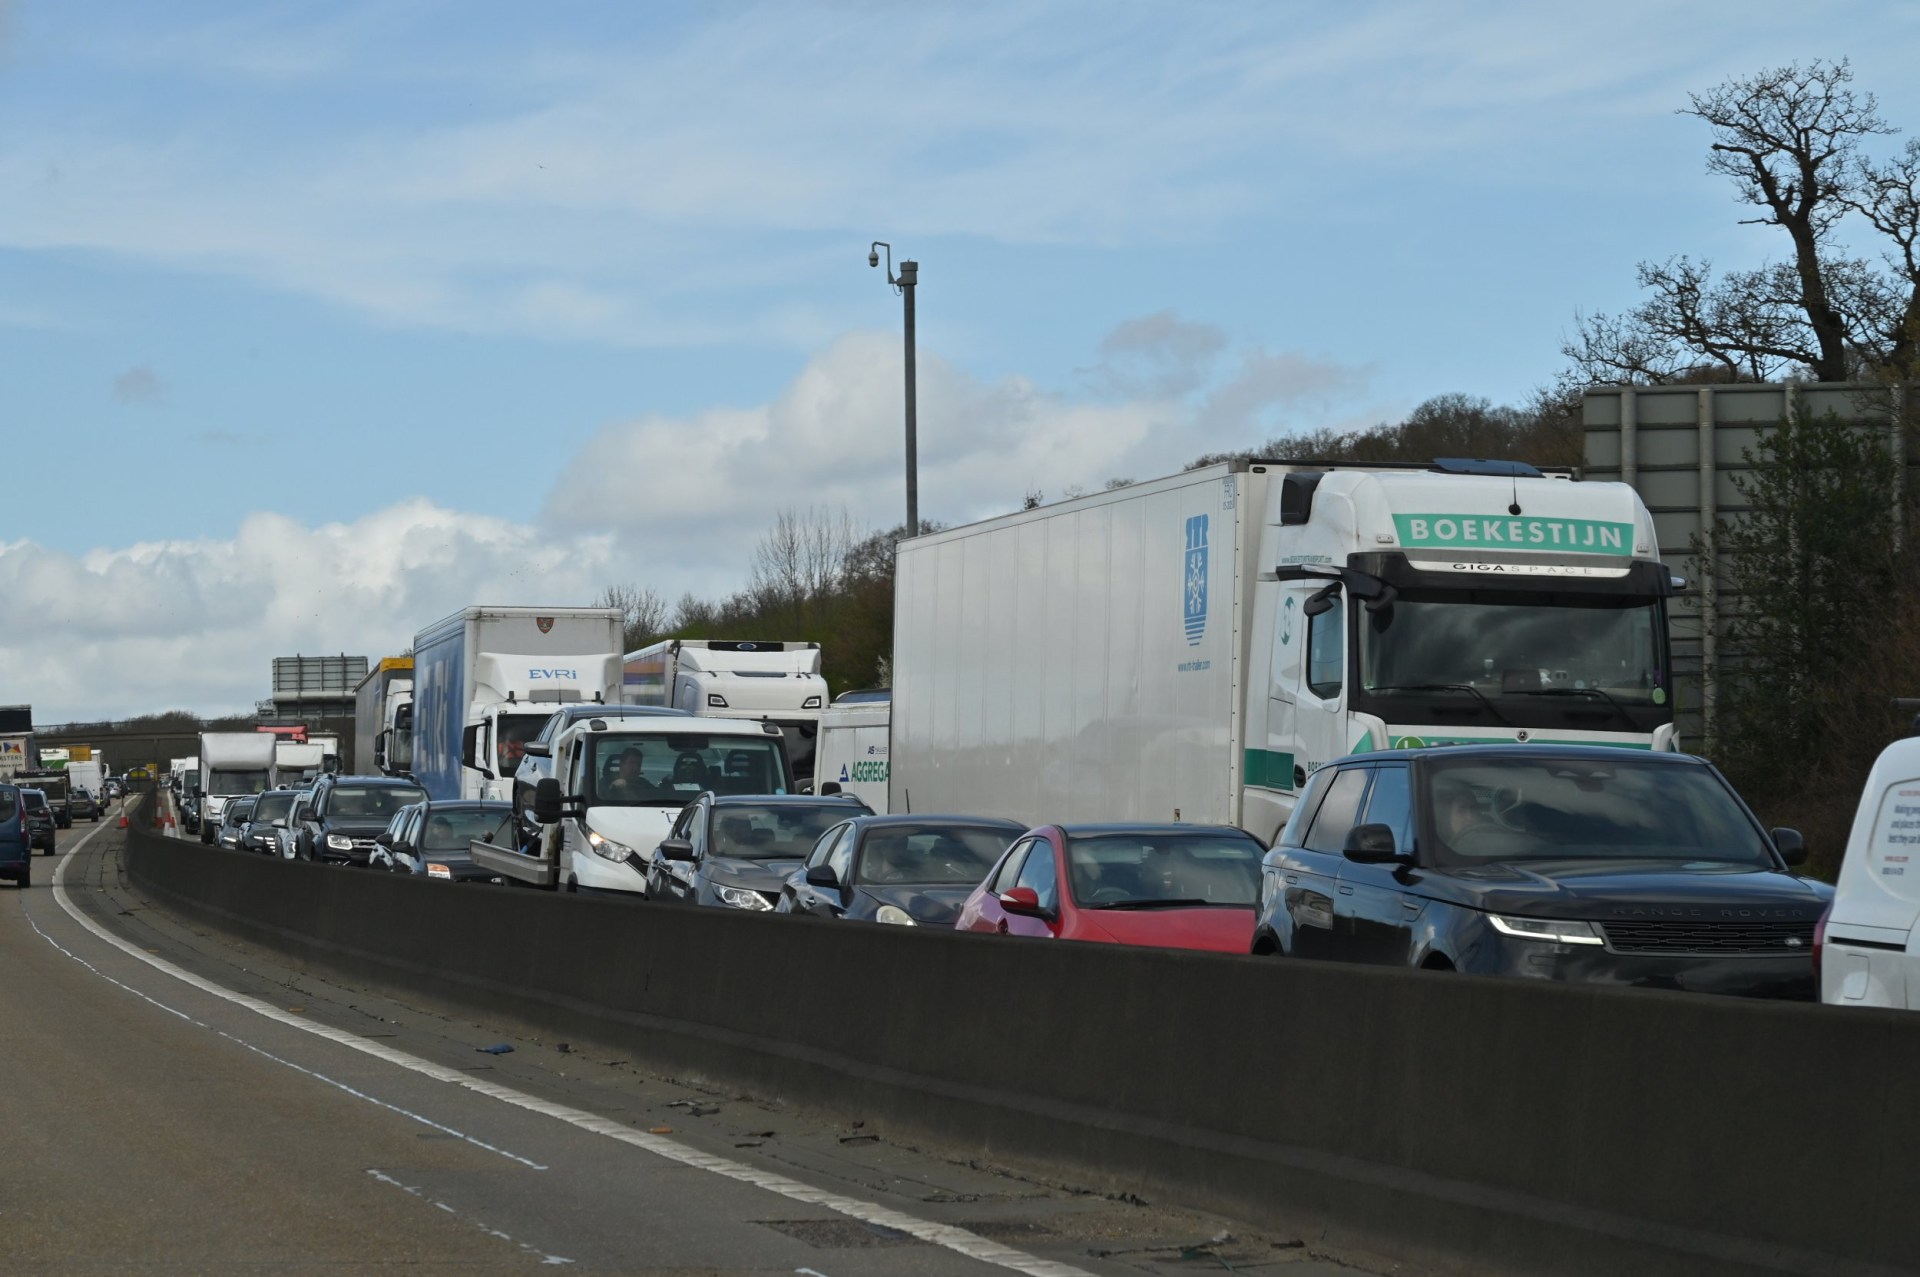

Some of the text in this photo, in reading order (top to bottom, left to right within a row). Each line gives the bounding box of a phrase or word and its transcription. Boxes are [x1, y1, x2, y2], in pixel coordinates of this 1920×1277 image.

[1410, 520, 1621, 547] BOEKESTIJN
[1613, 908, 1804, 917] RANGE ROVER
